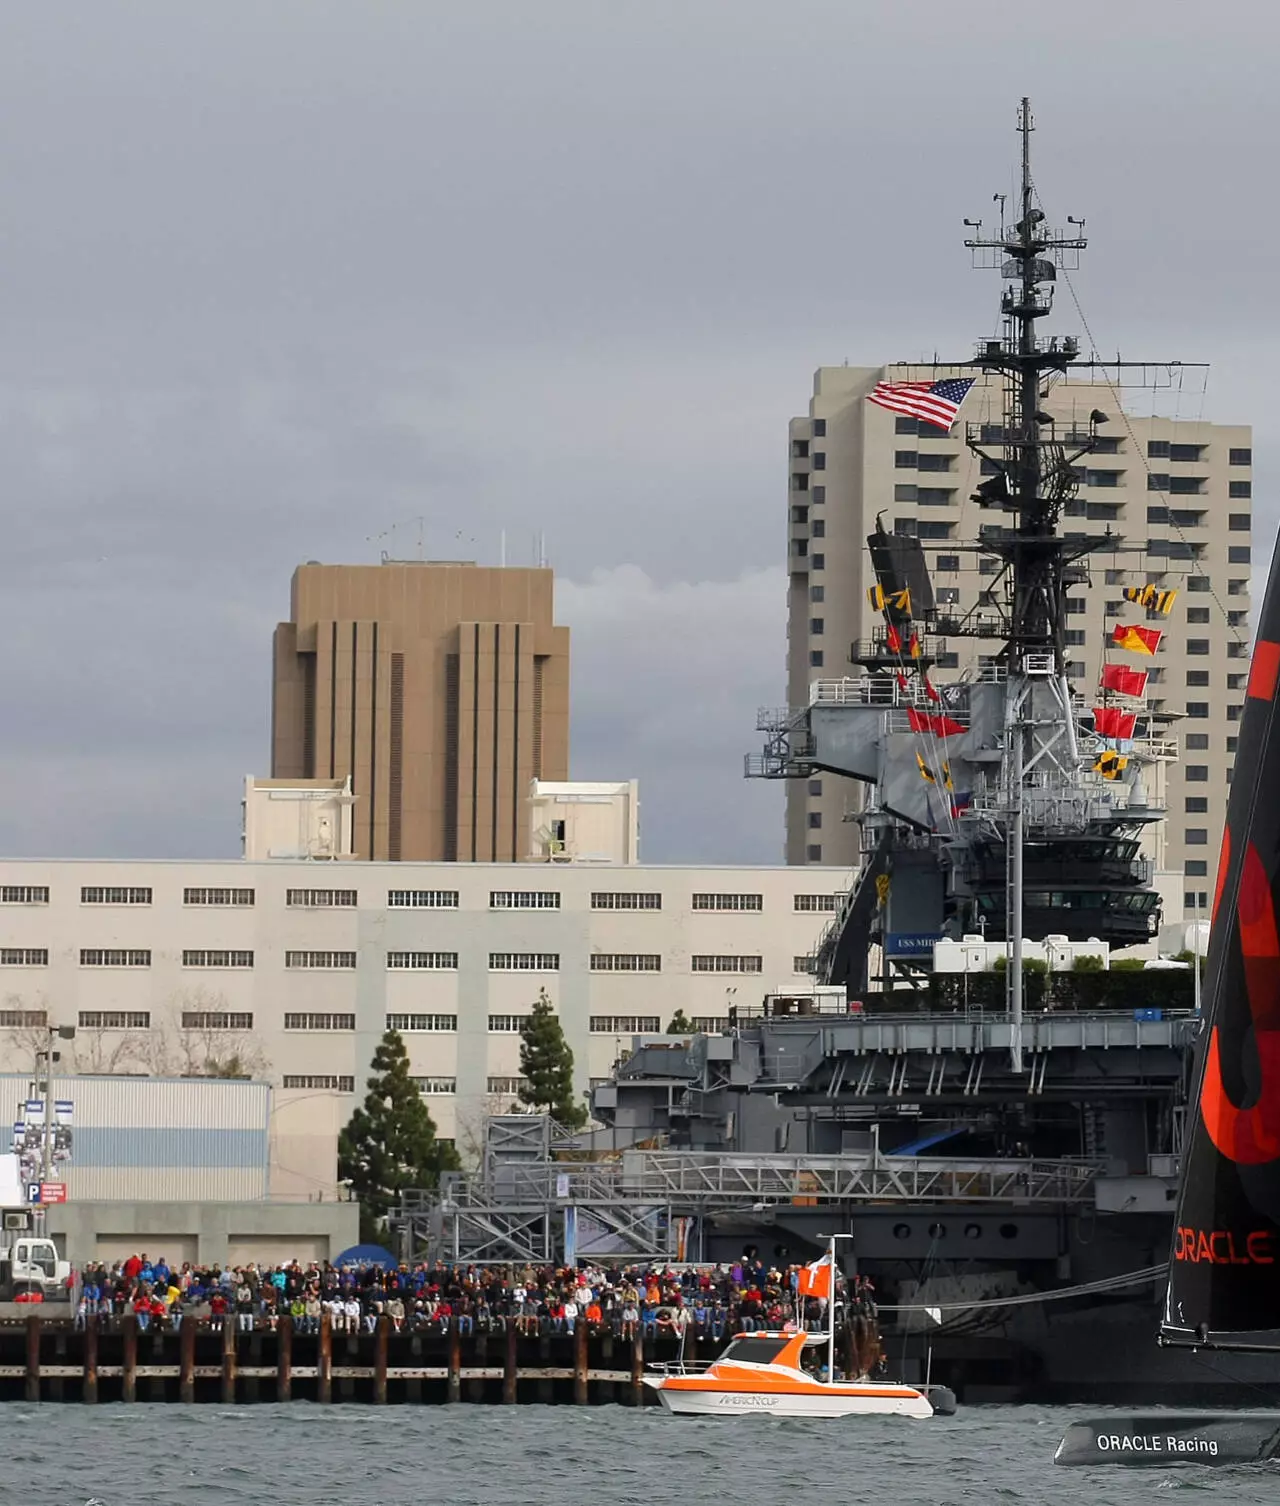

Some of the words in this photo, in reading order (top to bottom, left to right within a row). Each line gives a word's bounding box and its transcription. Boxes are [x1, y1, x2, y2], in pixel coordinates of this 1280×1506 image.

[28, 1184, 40, 1201] P
[1175, 1226, 1275, 1265] ORACLE
[1097, 1434, 1162, 1451] ORACLE
[1166, 1436, 1219, 1456] Racing
